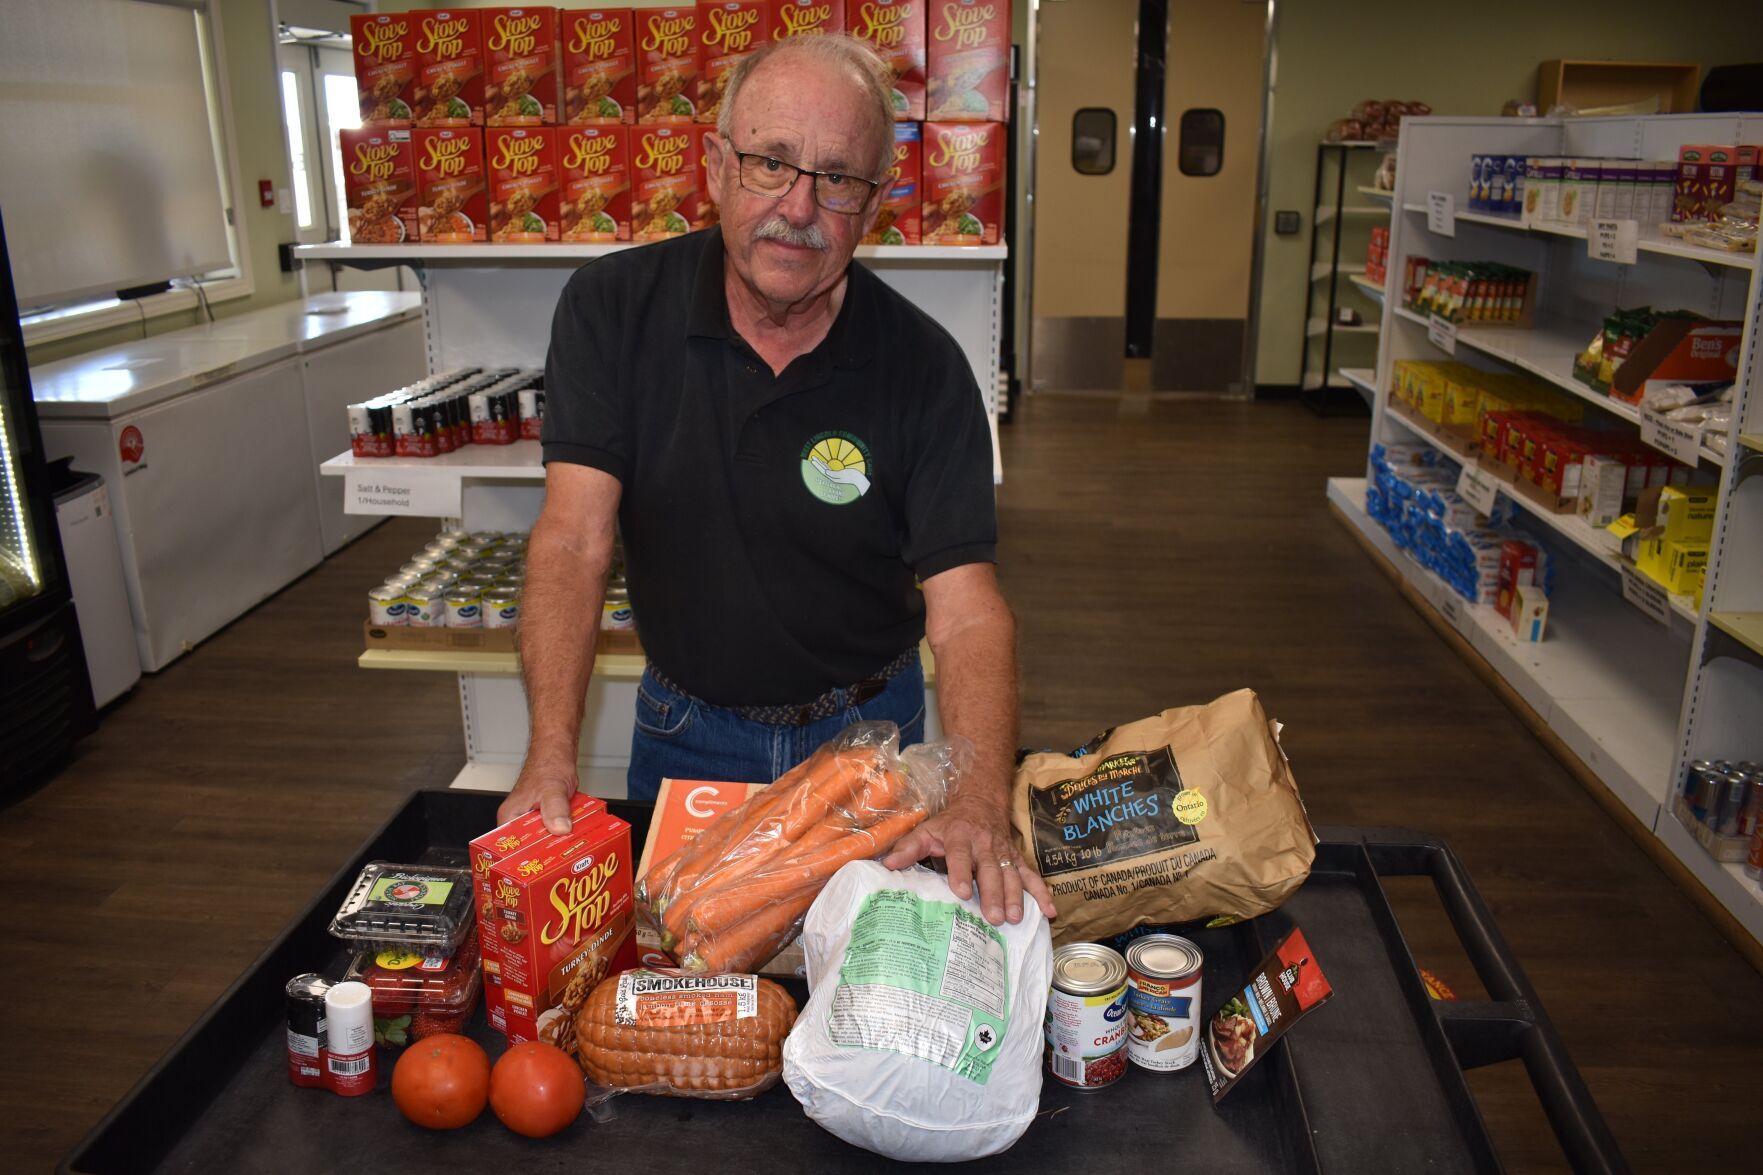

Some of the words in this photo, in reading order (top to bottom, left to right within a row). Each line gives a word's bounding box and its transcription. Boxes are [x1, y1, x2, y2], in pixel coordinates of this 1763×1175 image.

[702, 8, 760, 45] Stove
[773, 4, 832, 41] Stove
[854, 2, 913, 40] Stove
[935, 3, 996, 41] Stove
[359, 21, 408, 56] Stove
[417, 18, 470, 53] Stove
[488, 15, 542, 51] Stove
[569, 18, 622, 53] Stove
[642, 15, 696, 51] Stove
[723, 30, 752, 54] Top
[876, 25, 905, 48] Top
[957, 26, 987, 49] Top
[376, 41, 403, 64] Top
[435, 38, 463, 61] Top
[505, 35, 535, 59] Top
[588, 38, 615, 61] Top
[661, 36, 689, 59] Top
[350, 142, 400, 175] Stove
[419, 136, 472, 171] Stove
[492, 134, 545, 169] Stove
[563, 133, 617, 169] Stove
[635, 133, 690, 169] Stove
[929, 129, 989, 167] Stove
[369, 161, 395, 182] Top
[439, 155, 465, 178] Top
[511, 154, 538, 177] Top
[583, 154, 610, 177] Top
[656, 154, 684, 177] Top
[950, 152, 980, 176] Top
[357, 484, 373, 493] Salt
[375, 485, 381, 493] &
[382, 485, 411, 495] Pepper
[358, 496, 410, 507] 1/Household
[1074, 781, 1135, 814] WHITE
[1176, 801, 1204, 812] Ontario
[1063, 794, 1159, 840] BLANCHES
[576, 858, 590, 871] Kraft
[1045, 855, 1064, 867] 4.54
[1065, 853, 1078, 867] kg
[1081, 849, 1091, 860] 10
[1093, 847, 1102, 858] lb
[1052, 880, 1088, 896] PRODUCT
[1089, 877, 1099, 888] OF
[1101, 859, 1170, 884] CANADA/PRODUIT
[1170, 855, 1182, 869] DU
[1183, 848, 1217, 867] CANADA
[495, 879, 521, 898] Stove
[541, 852, 619, 946] Stove
[1083, 887, 1115, 901] CANADA
[505, 894, 518, 908] Top
[569, 890, 610, 947] Top
[561, 948, 589, 976] TURKEY
[591, 927, 614, 952] DINDE
[636, 977, 751, 992] SMOKEHOUSE
[1278, 971, 1292, 992] HOUSE
[1285, 968, 1296, 985] CLUB
[640, 993, 676, 1002] boneless
[738, 992, 747, 1001] kg
[1138, 986, 1168, 995] AMERICAN
[1255, 971, 1275, 1000] BROWN
[1266, 996, 1282, 1023] BRUNE
[640, 1002, 672, 1010] jambon
[738, 1001, 747, 1013] 1.5
[1106, 1007, 1120, 1018] Ocean
